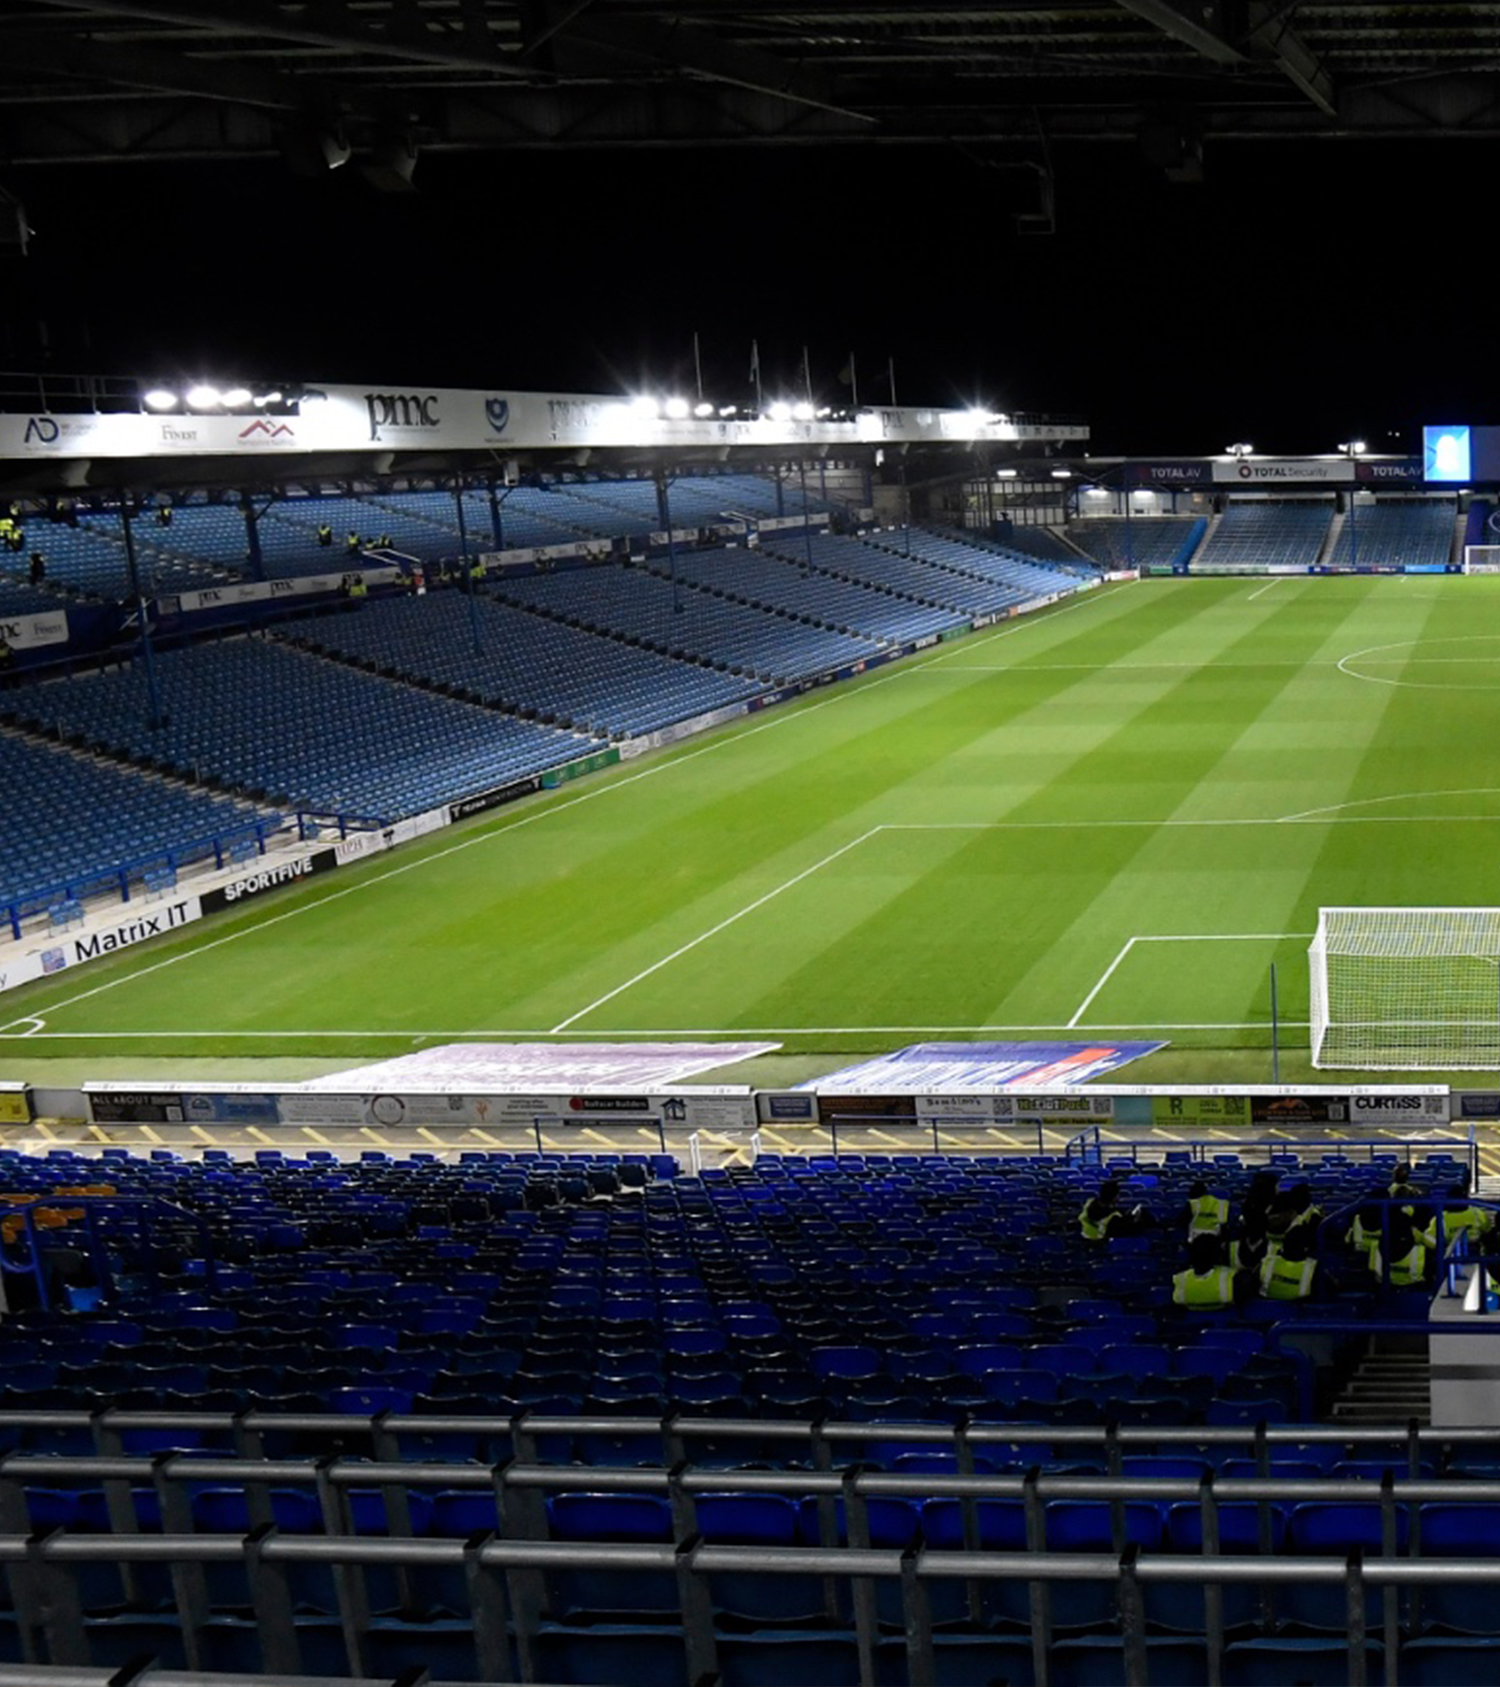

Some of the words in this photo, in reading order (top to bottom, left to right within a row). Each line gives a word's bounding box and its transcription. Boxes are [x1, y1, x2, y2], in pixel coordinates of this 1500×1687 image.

[364, 394, 440, 441] pmc
[225, 858, 312, 902] SPORTFIVE
[75, 914, 160, 962] Matrix
[168, 902, 189, 927] IT
[93, 1096, 110, 1105] ALL
[113, 1095, 150, 1105] ABOUT
[1356, 1096, 1422, 1110] CURTISS
